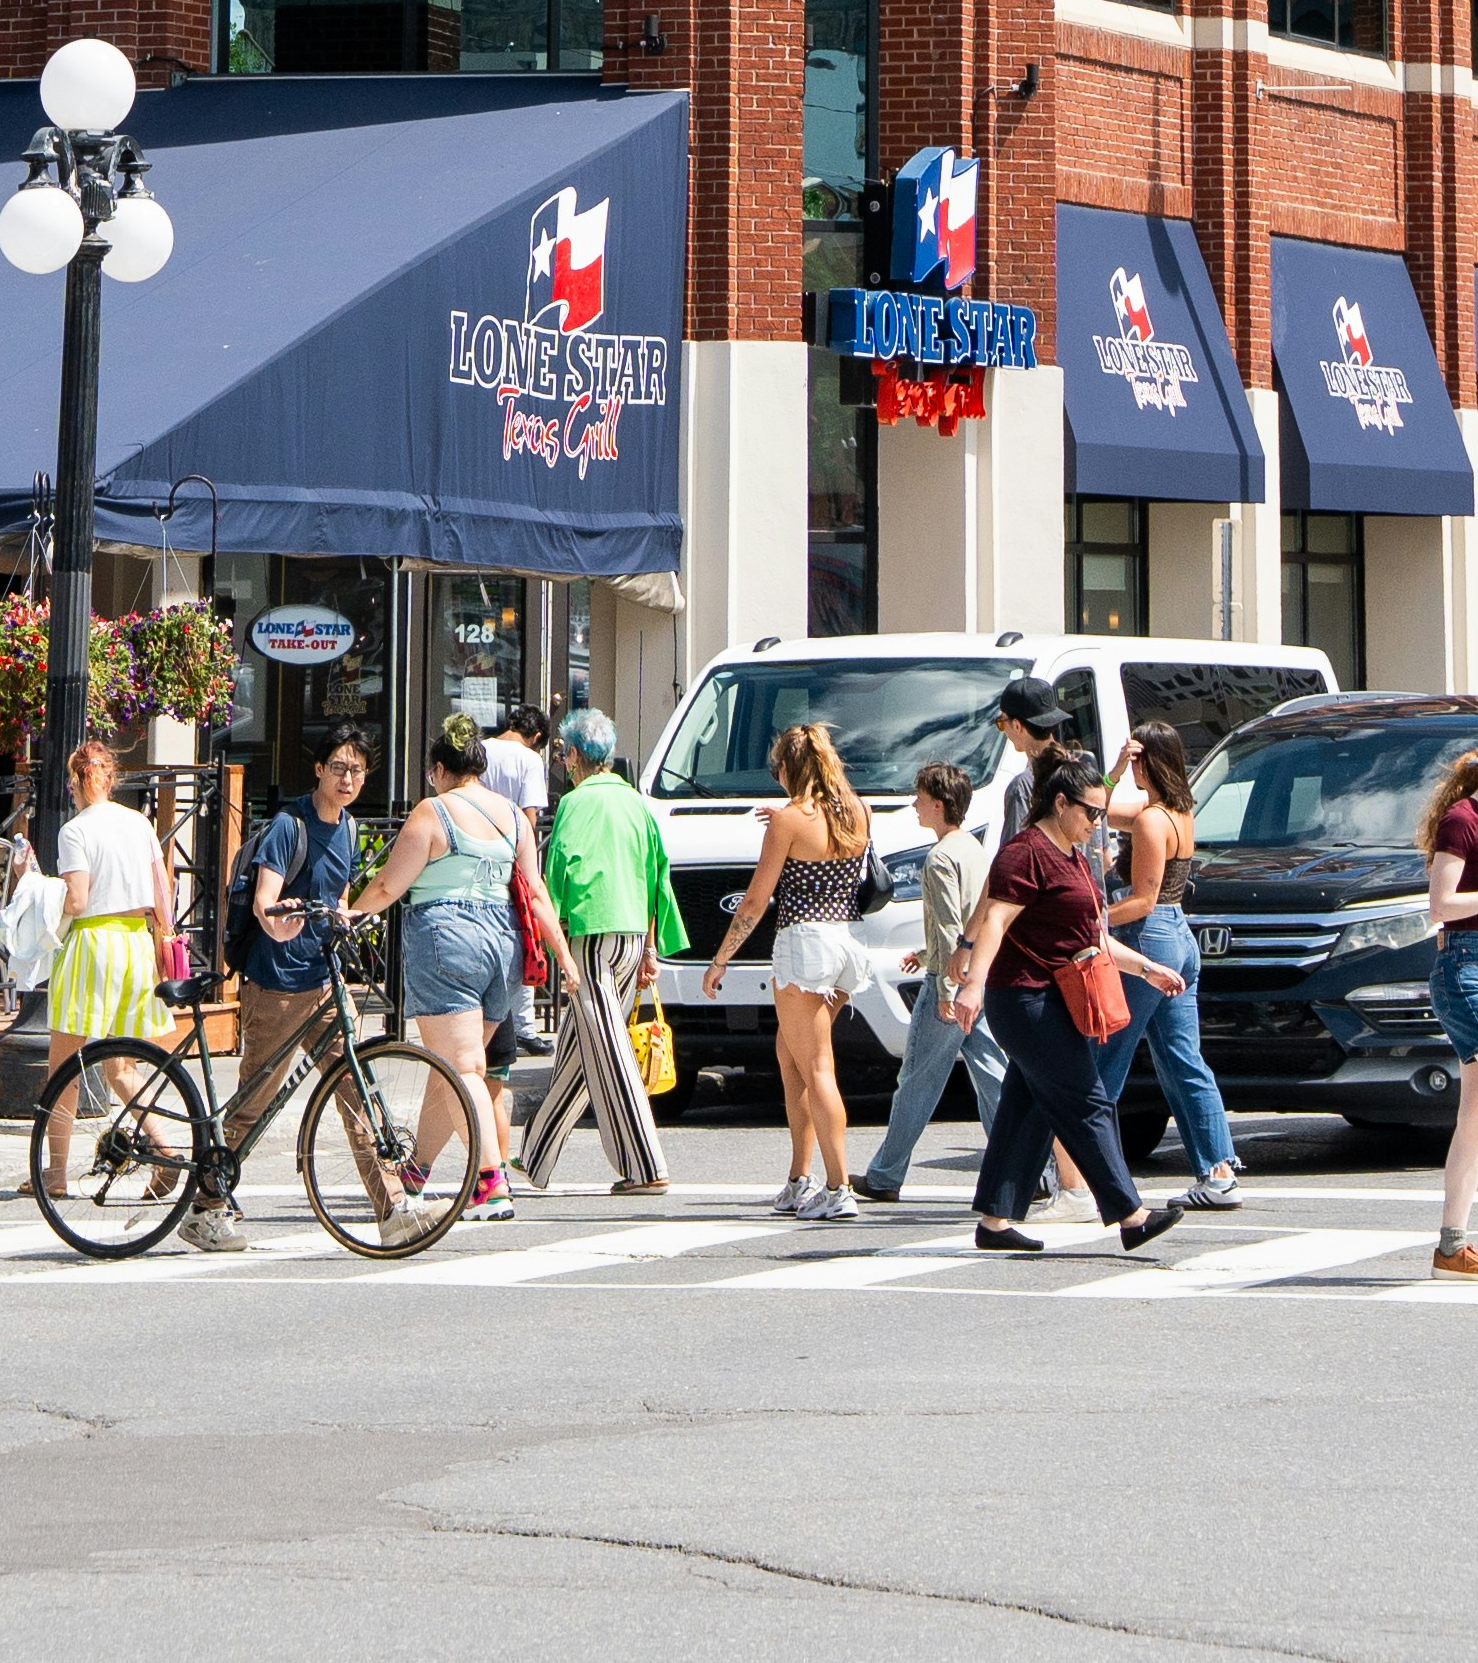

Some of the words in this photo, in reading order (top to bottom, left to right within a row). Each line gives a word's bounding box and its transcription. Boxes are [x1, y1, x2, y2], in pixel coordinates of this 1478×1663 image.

[852, 289, 944, 364] LONE
[945, 296, 1037, 370] STAR
[450, 310, 559, 400] LONE
[563, 331, 668, 405] STAR
[1092, 335, 1151, 377] LONE
[1145, 342, 1198, 382] STAR
[1320, 361, 1374, 399] LONE
[1366, 365, 1413, 403] STAR
[497, 387, 560, 468] Texas
[563, 394, 622, 480] Grill
[257, 622, 296, 636] LONE
[315, 623, 351, 636] STAR
[268, 639, 337, 651] TAKE-OUT
[454, 624, 494, 643] 128
